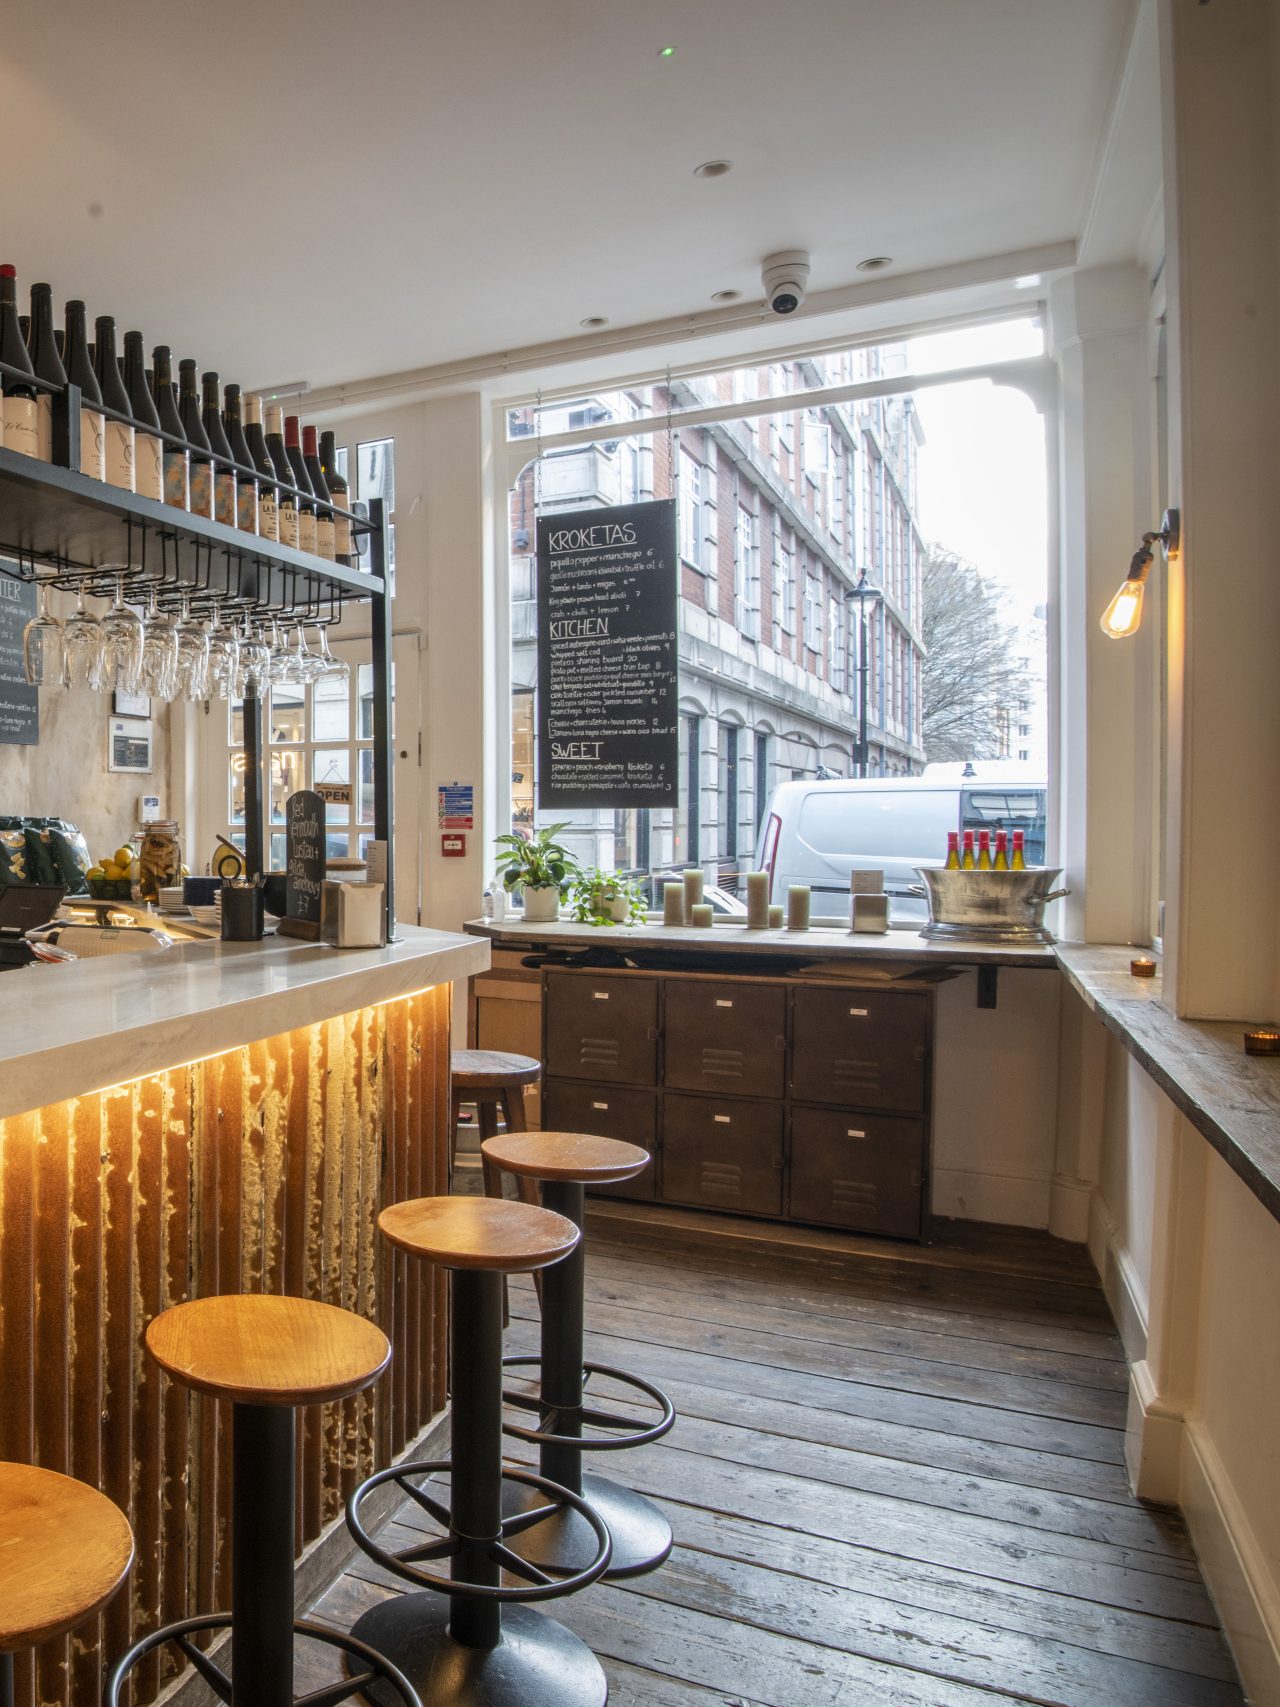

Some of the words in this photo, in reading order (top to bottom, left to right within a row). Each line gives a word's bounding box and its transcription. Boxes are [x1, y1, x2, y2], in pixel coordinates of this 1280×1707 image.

[549, 522, 636, 552] KROKETAS
[603, 550, 642, 561] manchego
[647, 548, 655, 556] 6
[646, 559, 655, 570] oil
[598, 606, 619, 614] lemon
[549, 617, 609, 638] KITCHEN
[669, 631, 676, 640] 8
[576, 657, 600, 666] sharing
[602, 654, 624, 662] board
[637, 662, 650, 671] top
[659, 688, 667, 696] 12
[551, 742, 604, 758] SWEET
[291, 795, 304, 818] Red
[288, 812, 319, 839] Vermouth
[293, 873, 320, 900] anchovy
